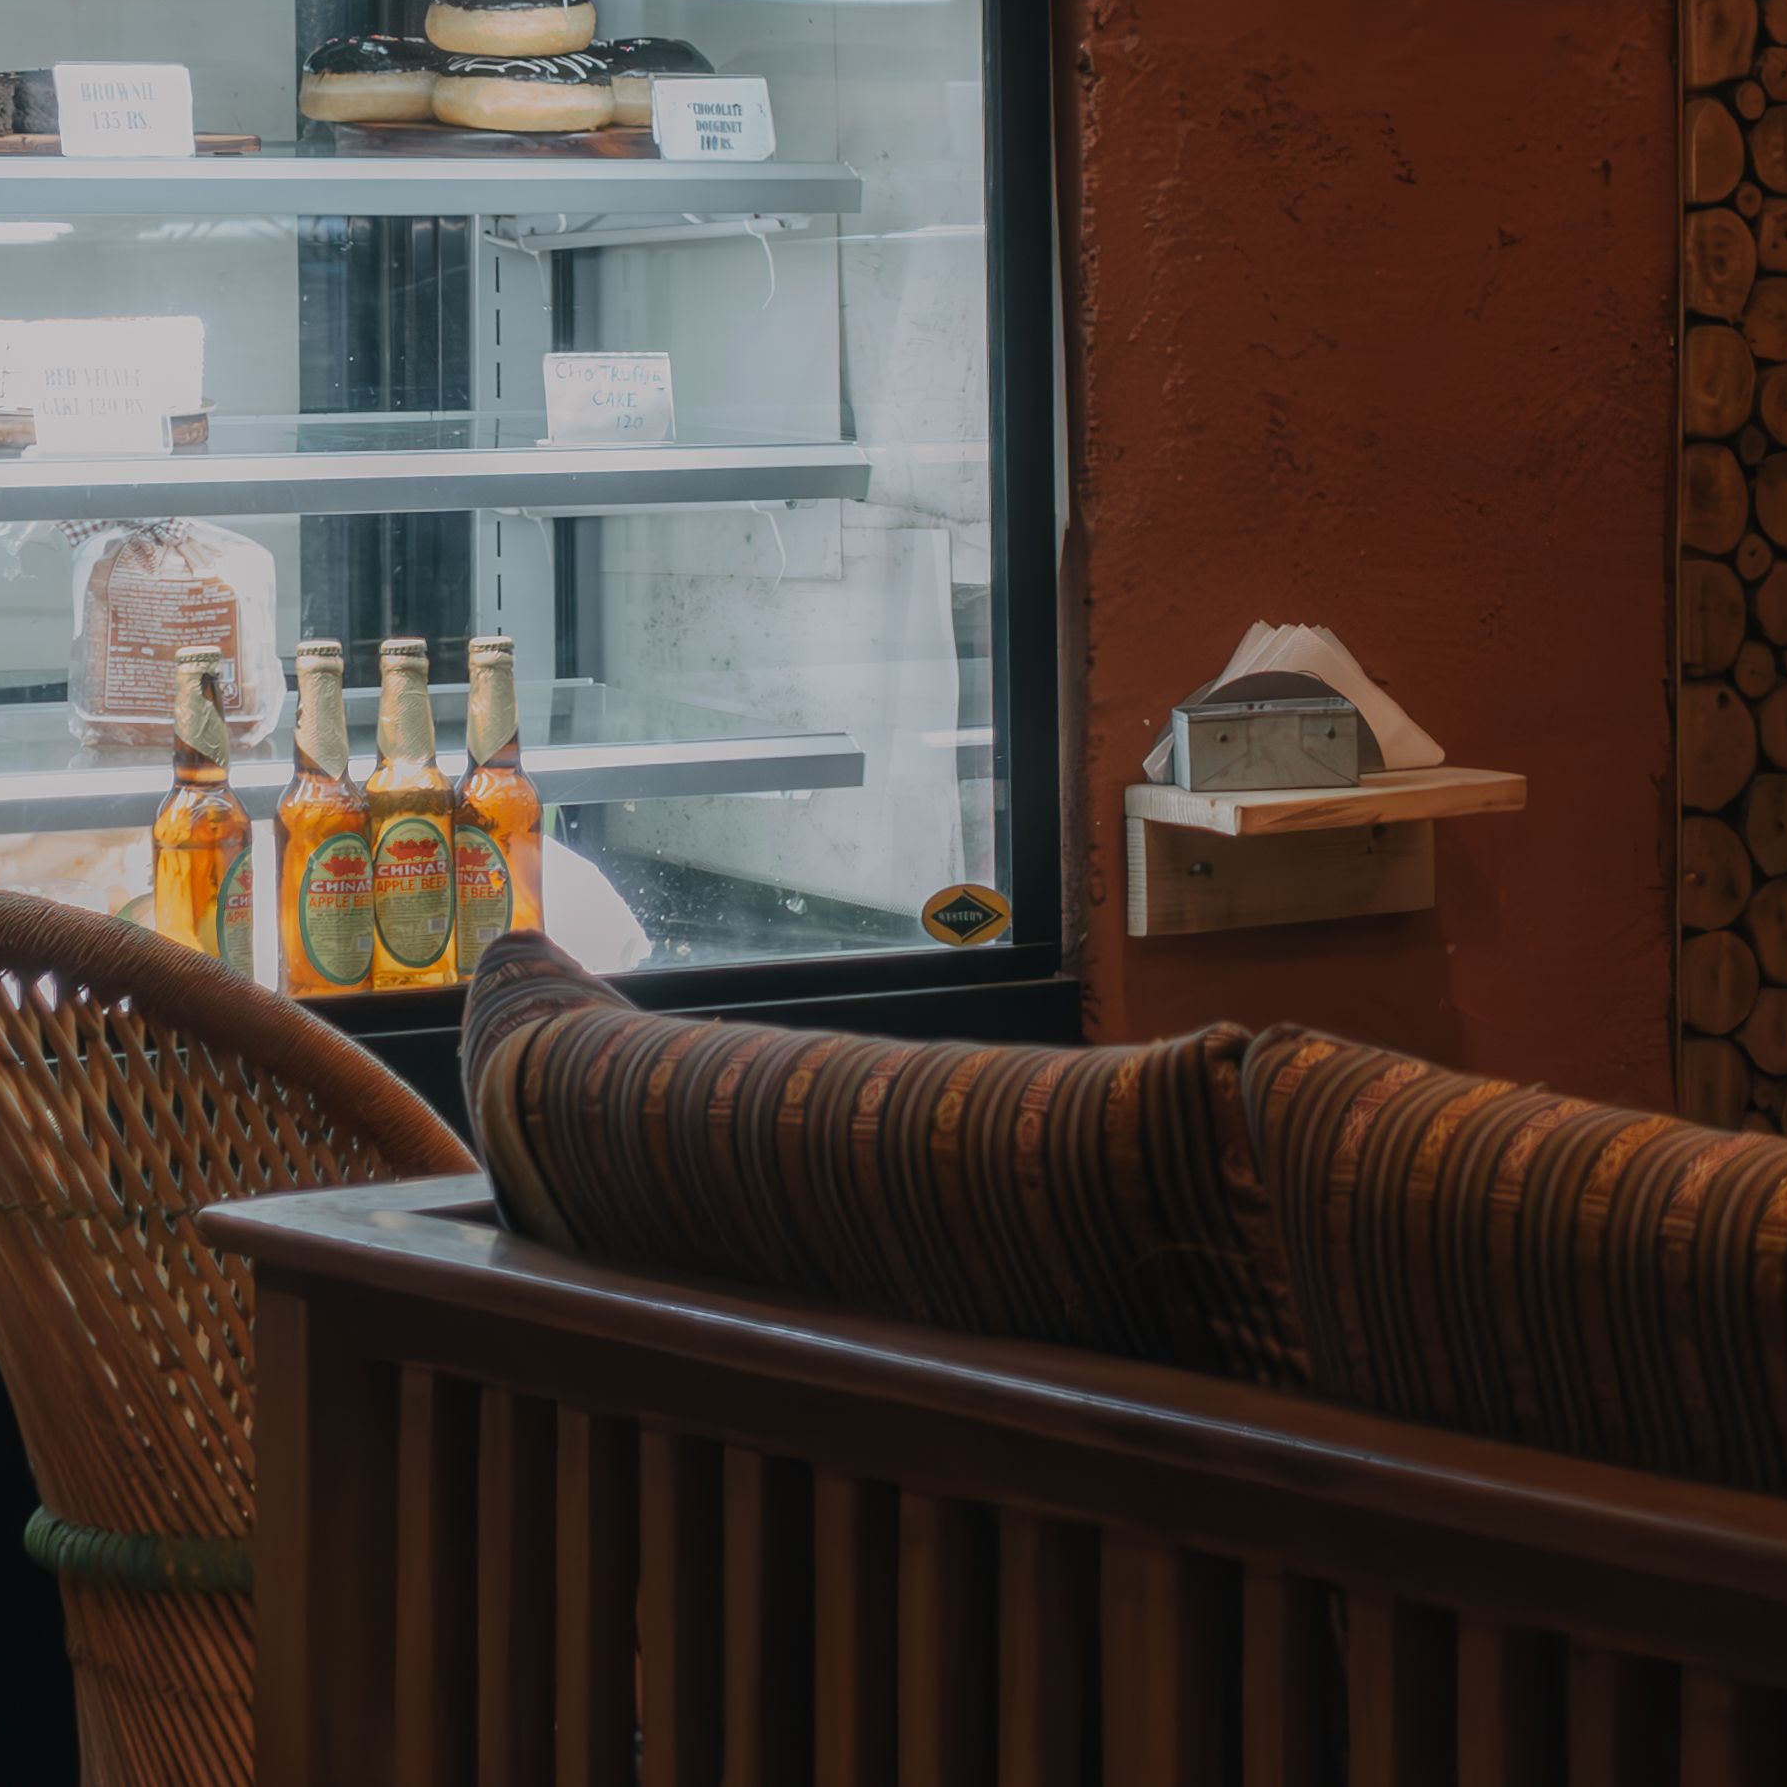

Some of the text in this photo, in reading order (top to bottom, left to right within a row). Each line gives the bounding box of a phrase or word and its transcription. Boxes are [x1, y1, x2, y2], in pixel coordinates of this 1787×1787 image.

[377, 861, 448, 878] CHINAR
[375, 878, 416, 894] APPLE
[308, 895, 351, 910] APPLE
